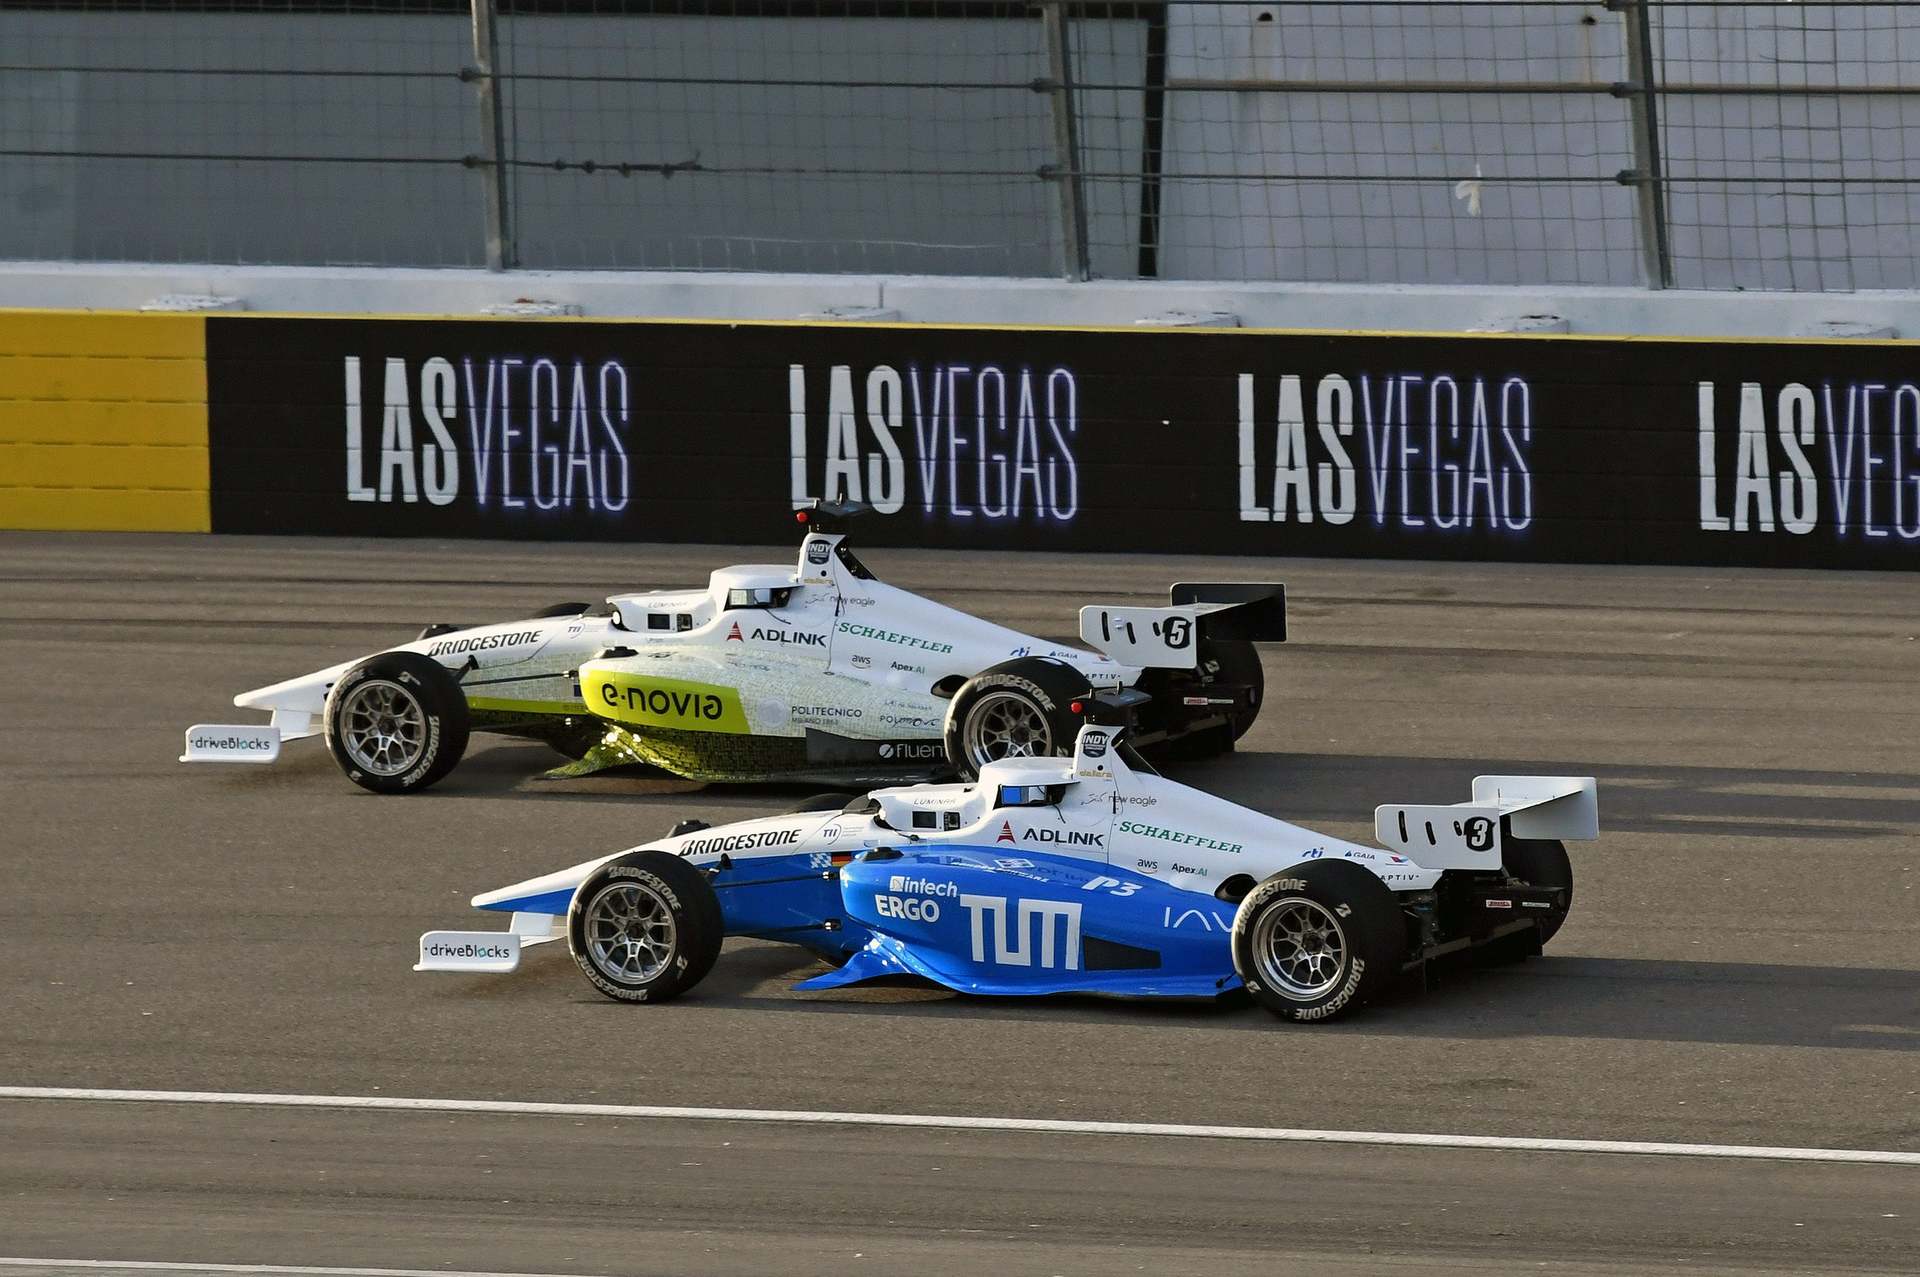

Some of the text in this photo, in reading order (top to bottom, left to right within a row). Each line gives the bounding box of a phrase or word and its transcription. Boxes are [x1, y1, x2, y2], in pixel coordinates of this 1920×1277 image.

[345, 356, 628, 511] LAS VEGAS
[789, 364, 1077, 520] LAS VEGAS
[1238, 373, 1531, 530] LAS VEGAS
[1698, 381, 1818, 535] LAS
[807, 543, 831, 552] INDY
[850, 598, 875, 608] eagle
[428, 630, 543, 656] BRIDGESTONE
[751, 628, 827, 648] ADLINK
[838, 621, 953, 654] SCHAEFFLER
[1168, 620, 1187, 645] 5
[852, 655, 871, 665] aws
[891, 660, 926, 674] Apex.AI
[1057, 651, 1078, 659] GAIA
[976, 673, 1057, 712] BRIDGESTONE
[791, 706, 862, 718] POLITECNICO
[402, 715, 440, 787] BRIDGESTONE
[896, 743, 945, 758] fluen
[1082, 734, 1109, 745] INDY
[1129, 796, 1157, 807] eagle
[679, 829, 802, 856] BRIDGESTONE
[1022, 828, 1105, 847] ADLINK
[1119, 820, 1243, 854] SCHAEFFLER
[1470, 819, 1489, 847] 3
[1137, 858, 1158, 870] aws
[1171, 861, 1208, 877] Apex.AI
[1353, 852, 1376, 860] GAIA
[608, 866, 682, 911] BRIDGESTONE
[904, 877, 958, 898] intech
[875, 894, 940, 923] ERGO
[1237, 878, 1308, 936] BRIDGESTONE
[959, 894, 1083, 971] TUM
[577, 954, 649, 1001] BRIDGESTONE
[1294, 955, 1365, 1020] BRIDGESTONE
